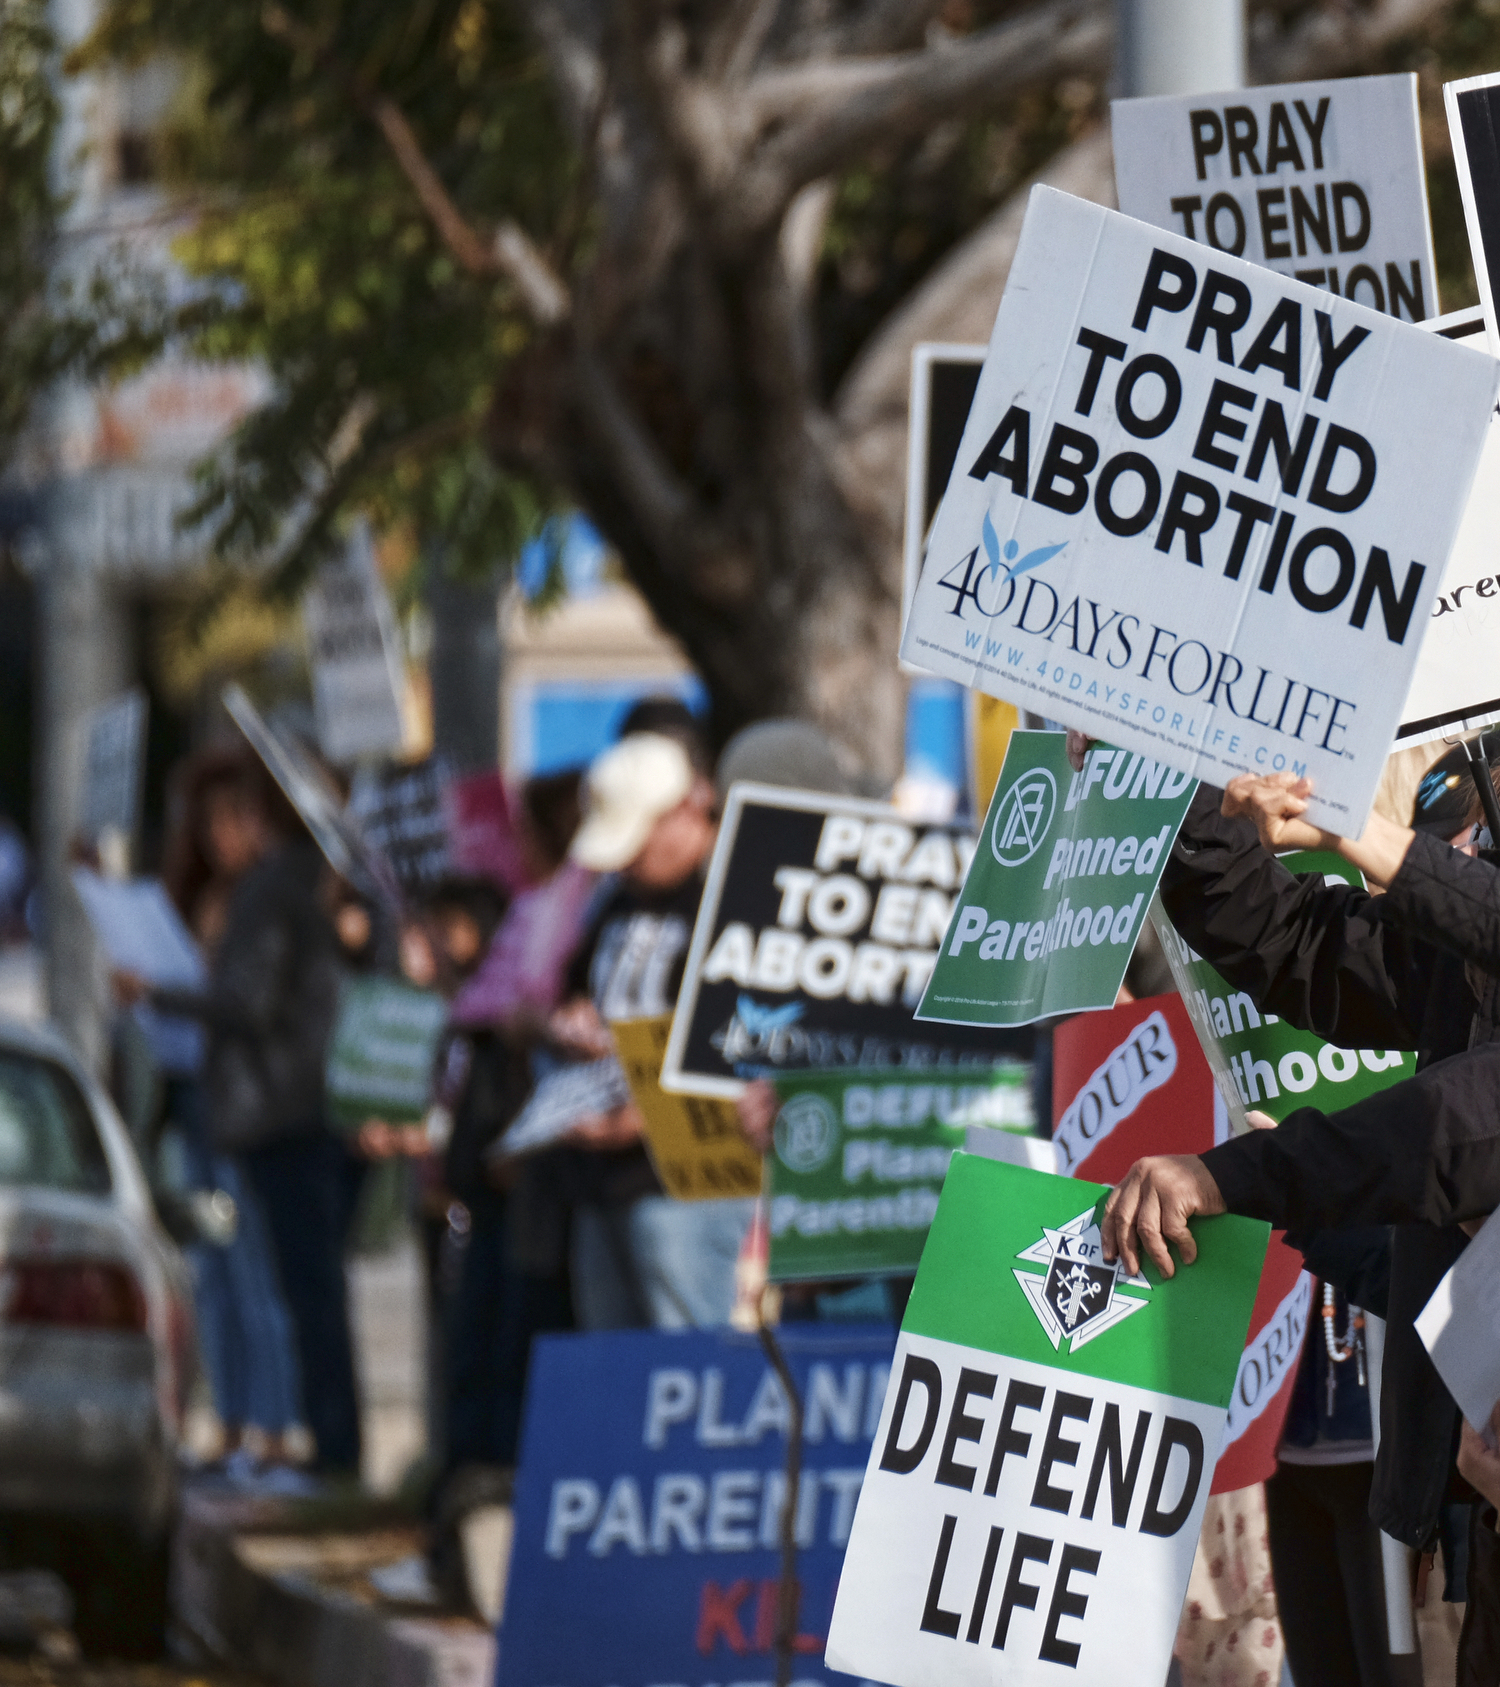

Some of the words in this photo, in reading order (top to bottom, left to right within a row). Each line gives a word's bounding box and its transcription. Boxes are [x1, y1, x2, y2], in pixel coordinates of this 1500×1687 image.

[1189, 96, 1331, 181] PRAY
[1170, 191, 1247, 258] TO
[1256, 181, 1372, 260] END
[1132, 247, 1372, 402] PRAY
[1074, 326, 1183, 440] TO
[1192, 378, 1377, 514] END
[968, 405, 1427, 645] ABORTION
[965, 629, 1307, 778] WWW.40DAYSFORLIFE.COM
[774, 866, 872, 937] TO
[870, 880, 962, 948] EN
[702, 922, 942, 1012] ABORT
[1058, 1024, 1170, 1167] YOUR
[844, 1139, 951, 1184] Plan
[1057, 1235, 1075, 1257] K
[1078, 1242, 1099, 1258] OF
[642, 1363, 893, 1451] PLAN
[878, 1354, 1206, 1538] DEFEND
[544, 1468, 866, 1558] PARENT
[919, 1514, 1103, 1670] LIFE
